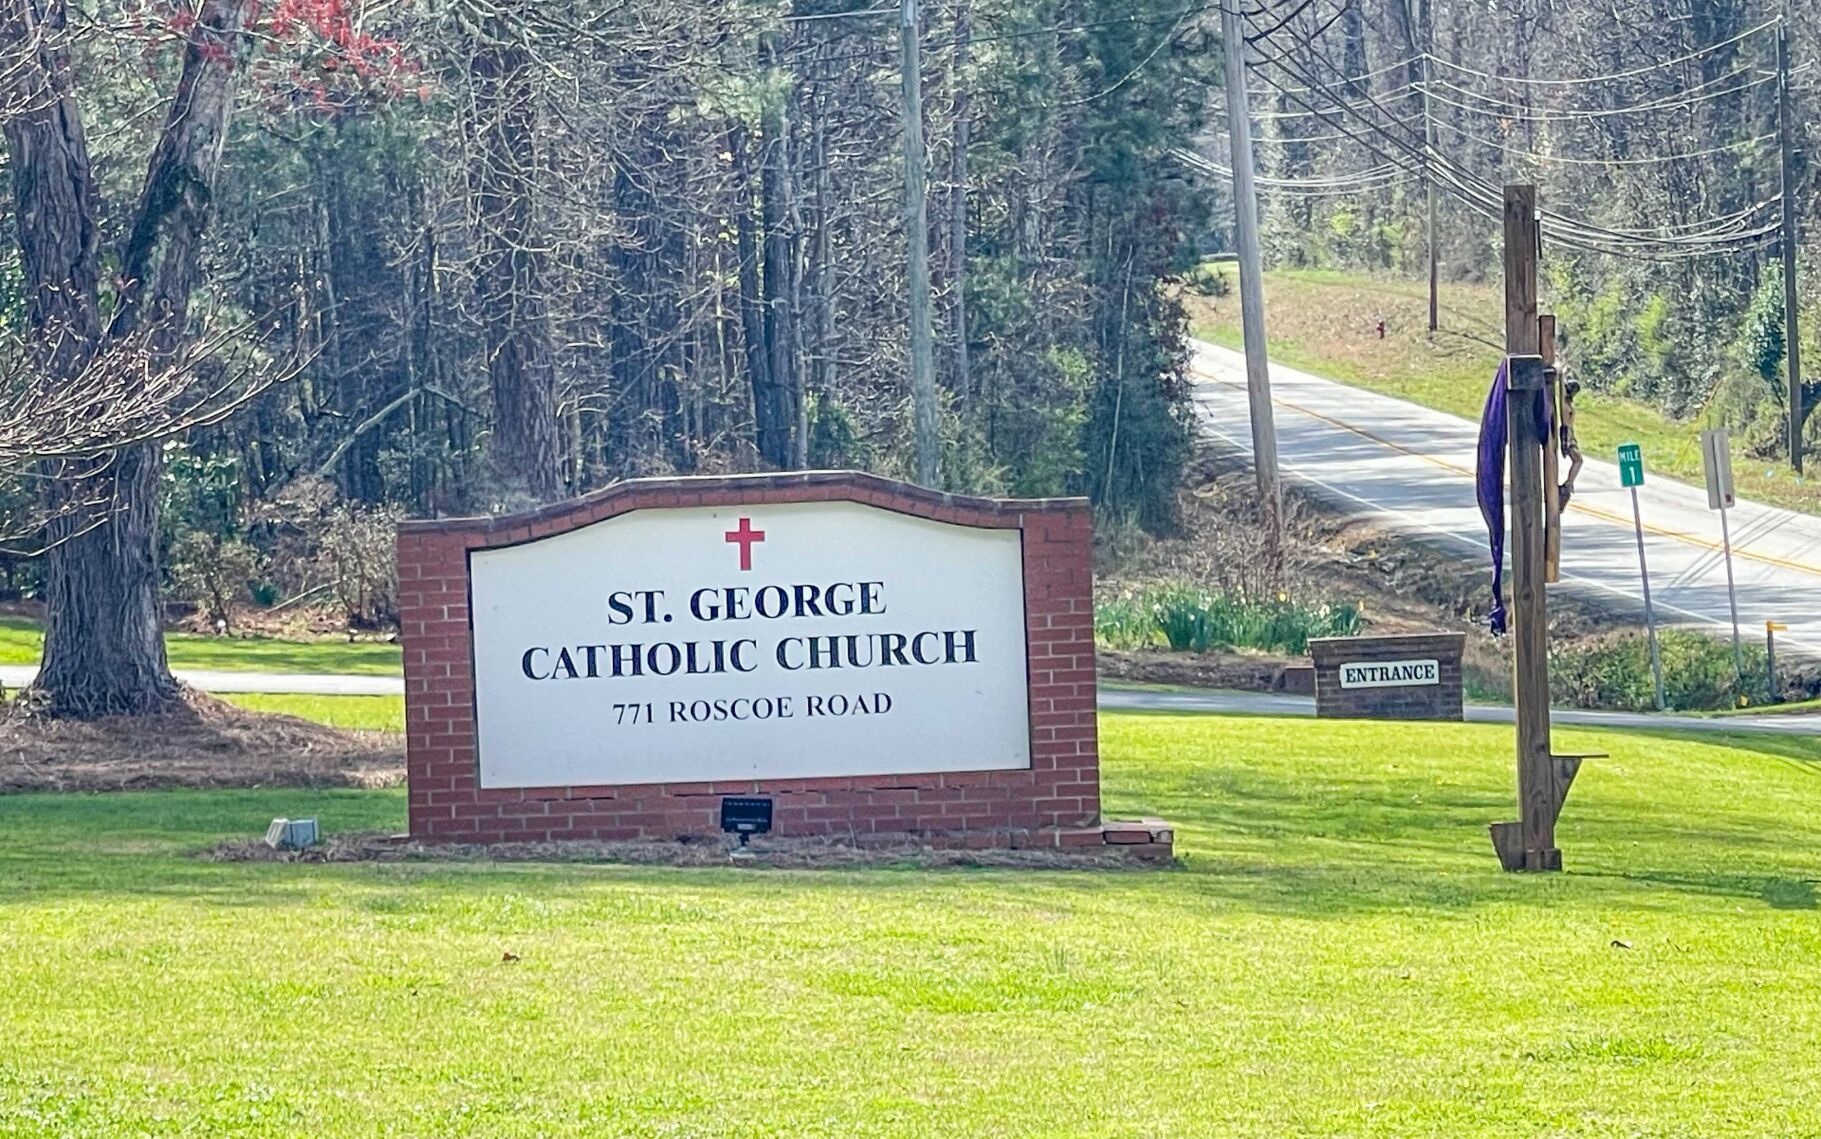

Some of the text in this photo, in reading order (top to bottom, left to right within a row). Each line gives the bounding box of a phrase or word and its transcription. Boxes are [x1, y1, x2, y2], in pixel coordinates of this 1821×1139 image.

[1619, 450, 1640, 462] MILE
[1629, 466, 1636, 484] 1
[608, 582, 886, 625] ST. GEORGE
[522, 630, 979, 680] CATHOLIC CHURCH
[1345, 665, 1435, 683] ENTRANCE
[612, 693, 892, 725] 771 ROSCOE ROAD
